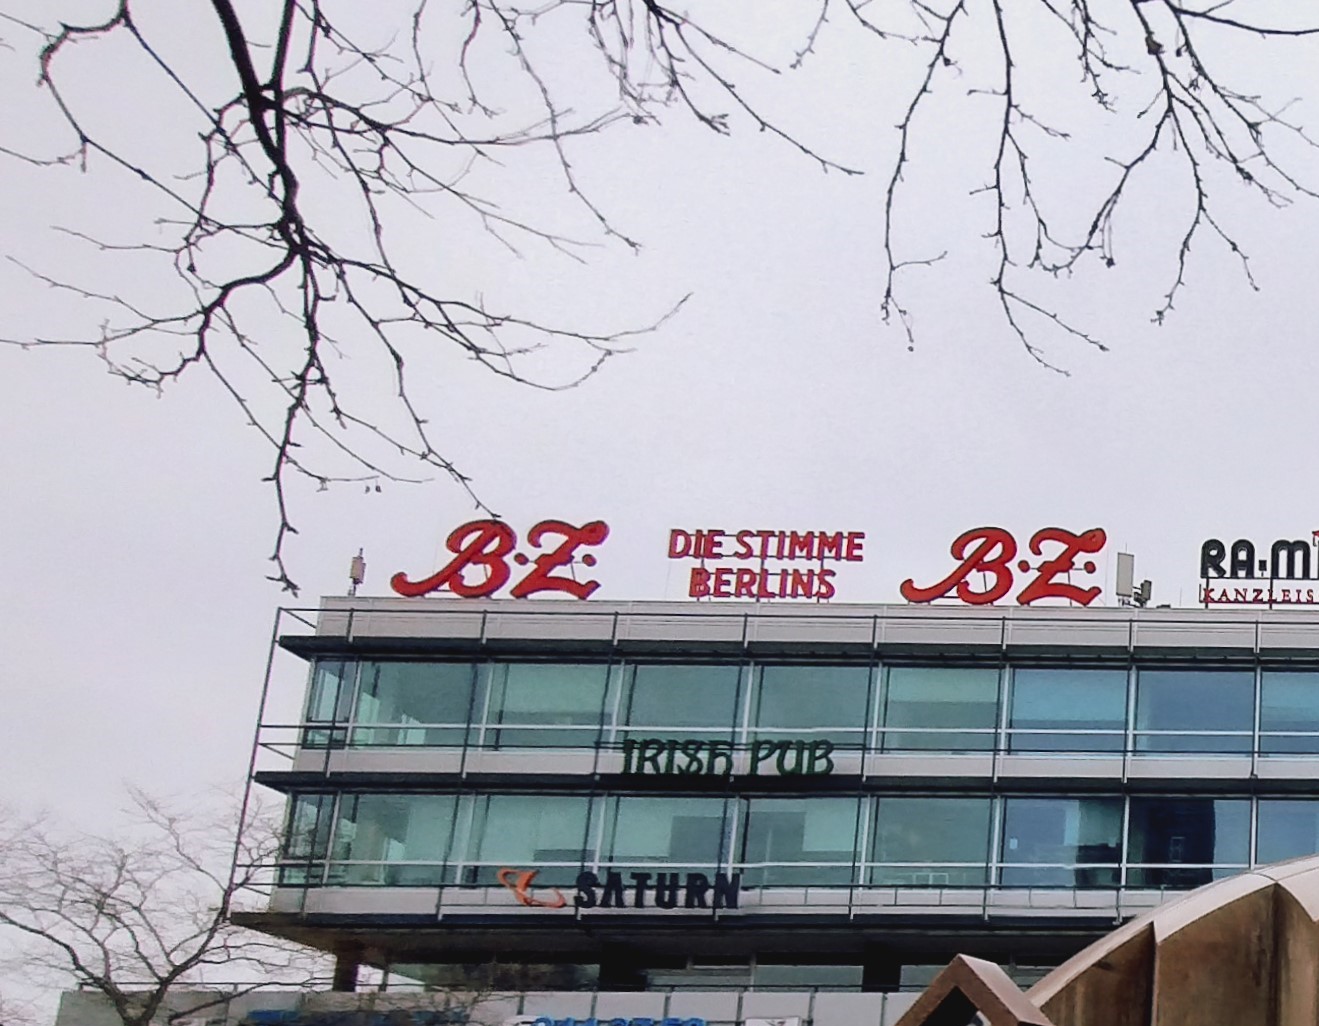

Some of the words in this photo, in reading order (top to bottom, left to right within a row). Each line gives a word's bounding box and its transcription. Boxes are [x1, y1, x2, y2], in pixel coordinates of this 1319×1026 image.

[668, 528, 725, 559] DIE
[734, 529, 865, 561] STIMME
[688, 568, 836, 599] BERLINS
[750, 738, 835, 777] PUB
[573, 871, 741, 909] SATURN
